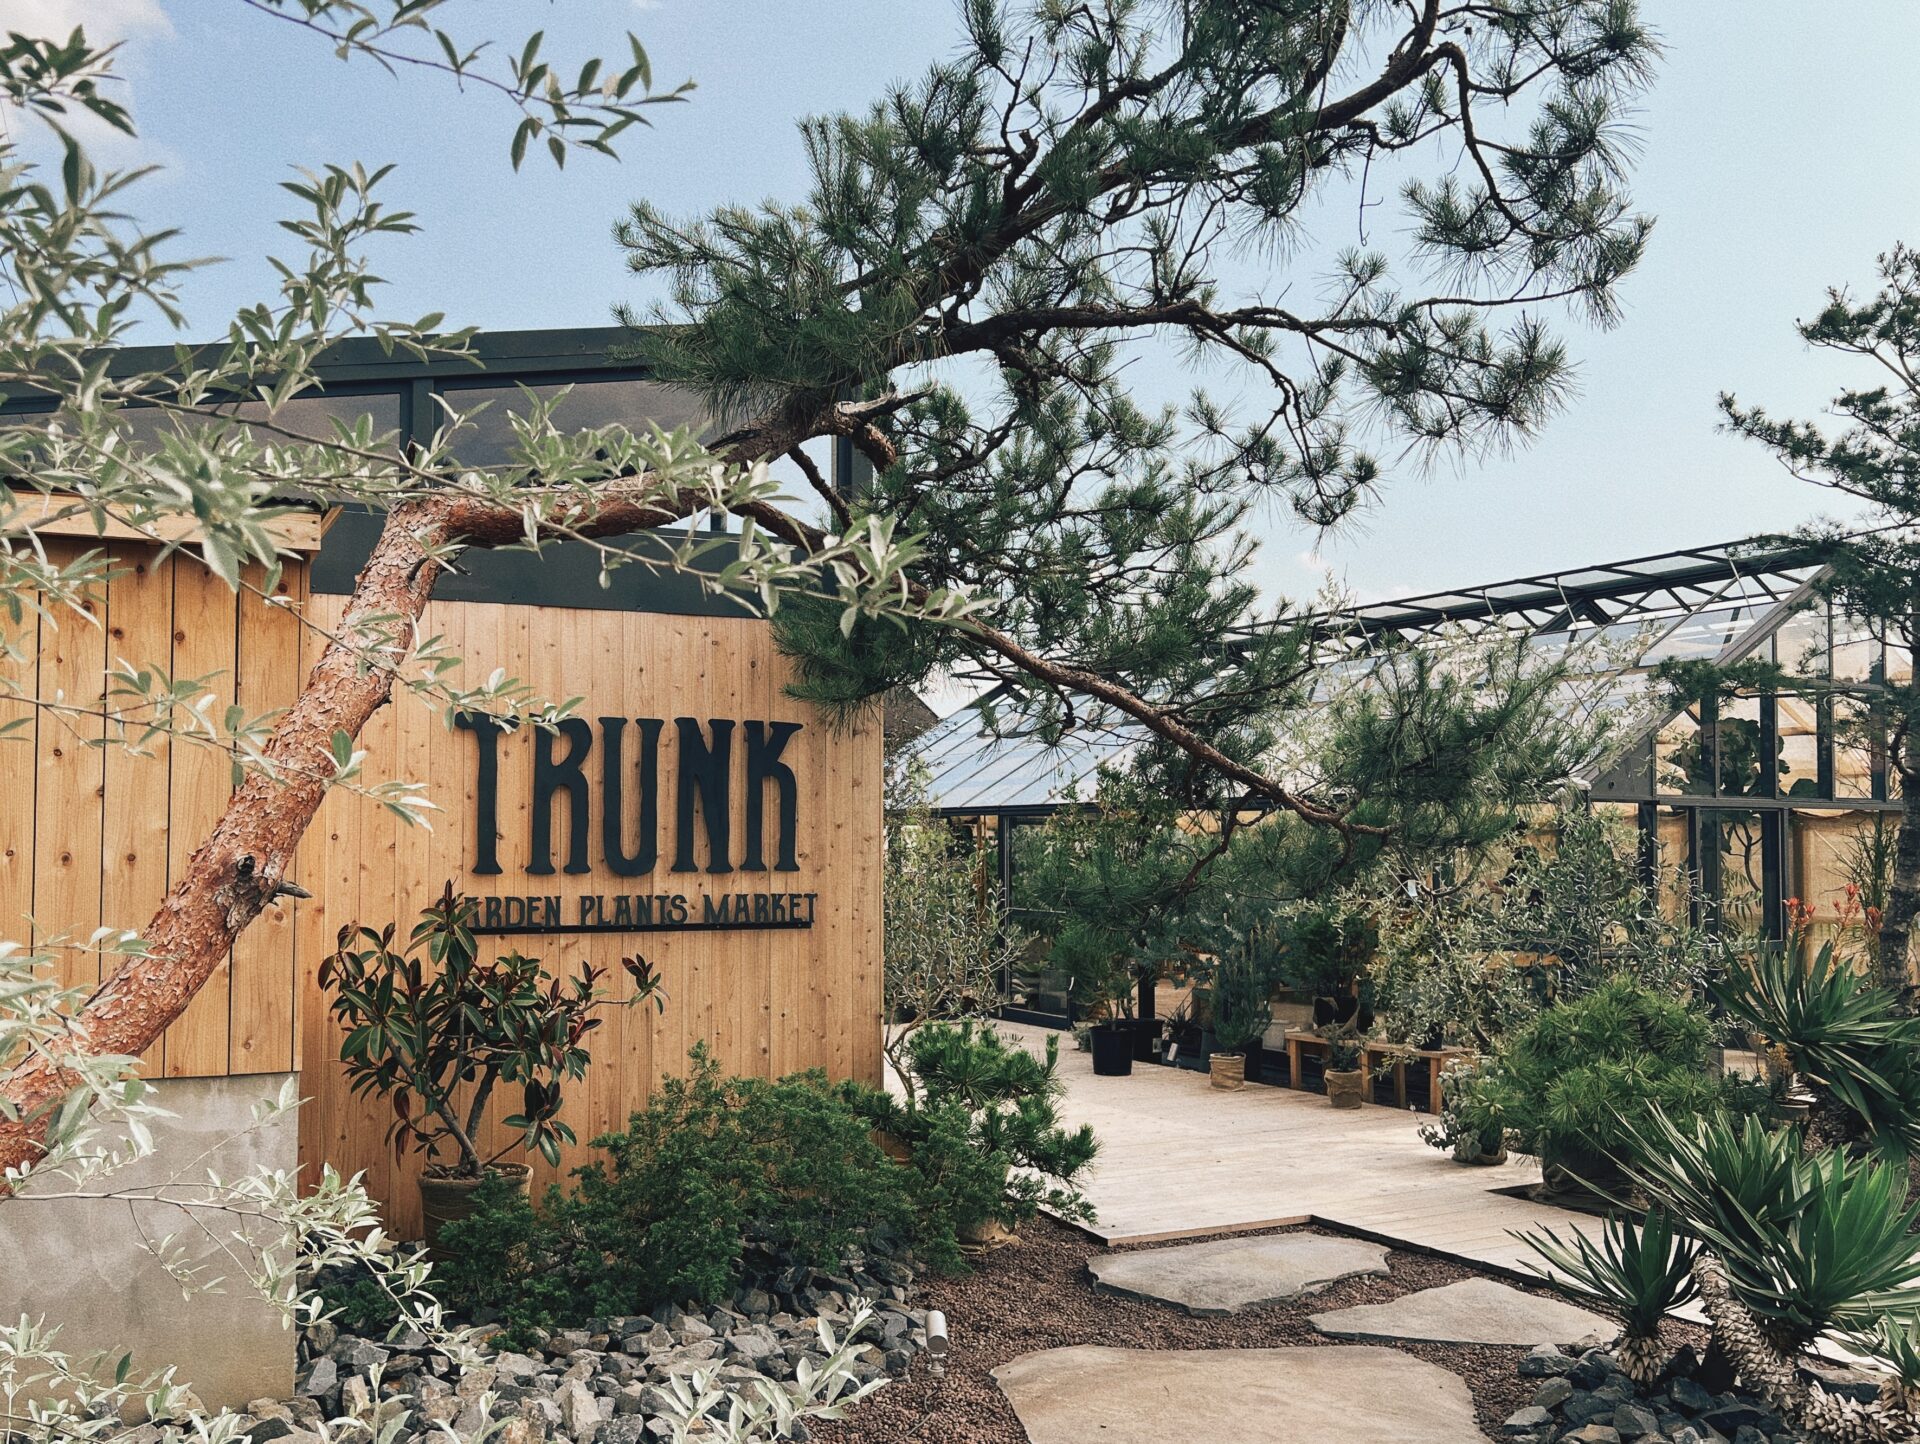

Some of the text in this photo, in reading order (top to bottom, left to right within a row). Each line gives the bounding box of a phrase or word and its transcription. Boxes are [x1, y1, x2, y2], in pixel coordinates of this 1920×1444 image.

[455, 712, 804, 877] TRUNK
[579, 894, 688, 925] PLANTS
[703, 893, 818, 923] MARKET
